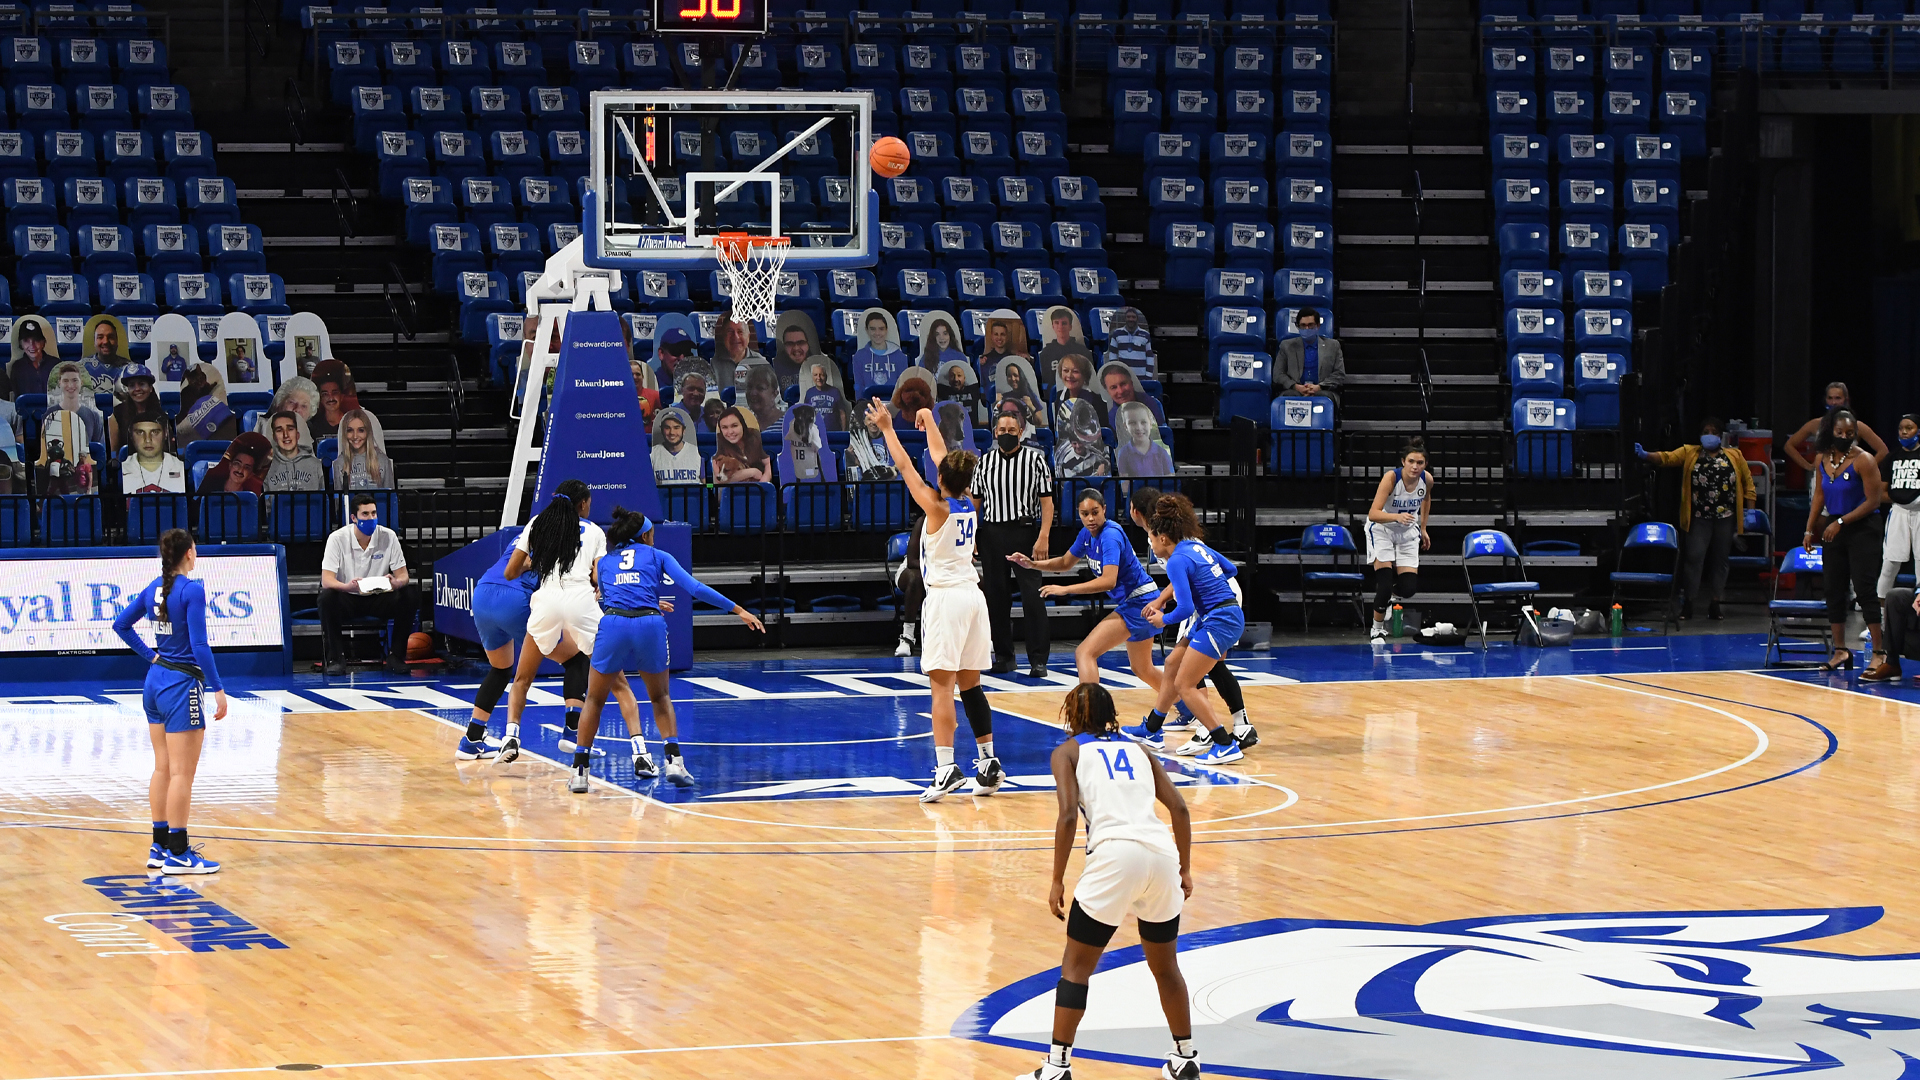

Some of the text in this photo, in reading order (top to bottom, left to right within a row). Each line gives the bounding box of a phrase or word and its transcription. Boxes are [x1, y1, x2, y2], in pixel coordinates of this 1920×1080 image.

[573, 341, 623, 350] @edwardjones
[864, 362, 896, 373] SLU
[575, 412, 626, 420] @edwardjones
[655, 469, 697, 481] BILLIKENS
[1893, 469, 1919, 479] LIVES
[956, 519, 974, 547] 34
[619, 549, 636, 570] 3
[1193, 544, 1215, 565] 2
[613, 572, 640, 585] JONES
[87, 578, 254, 622] Bks
[189, 687, 200, 726] TIGERS
[1097, 748, 1136, 781] 14
